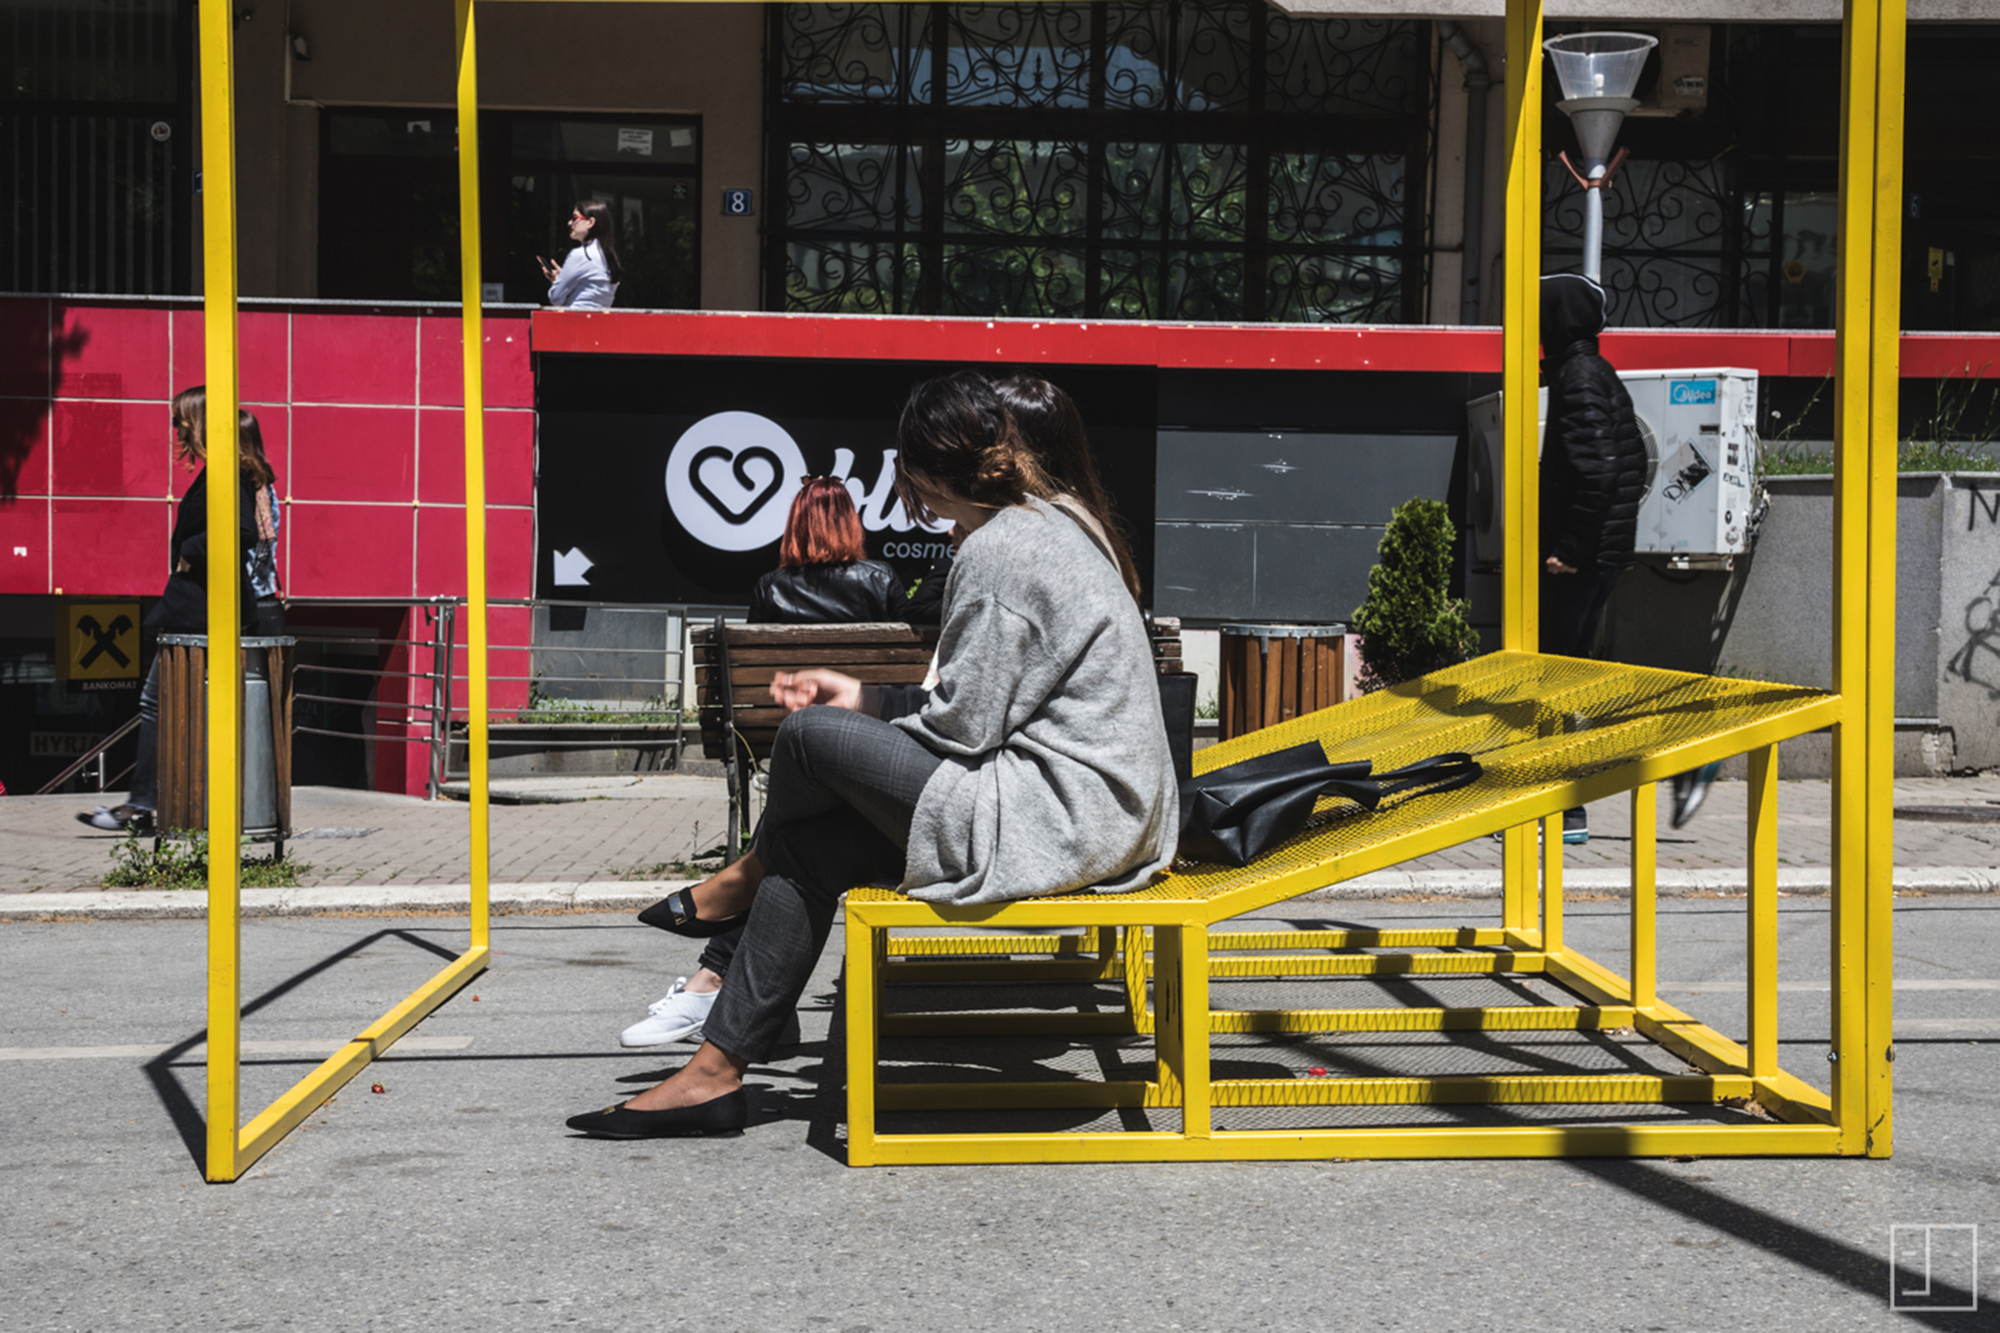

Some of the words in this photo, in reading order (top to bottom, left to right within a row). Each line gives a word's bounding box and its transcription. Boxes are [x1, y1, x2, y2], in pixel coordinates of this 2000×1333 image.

[731, 191, 745, 213] 8
[1674, 385, 1712, 402] Midea
[883, 541, 956, 559] cosme
[82, 681, 137, 691] BANKOMAT
